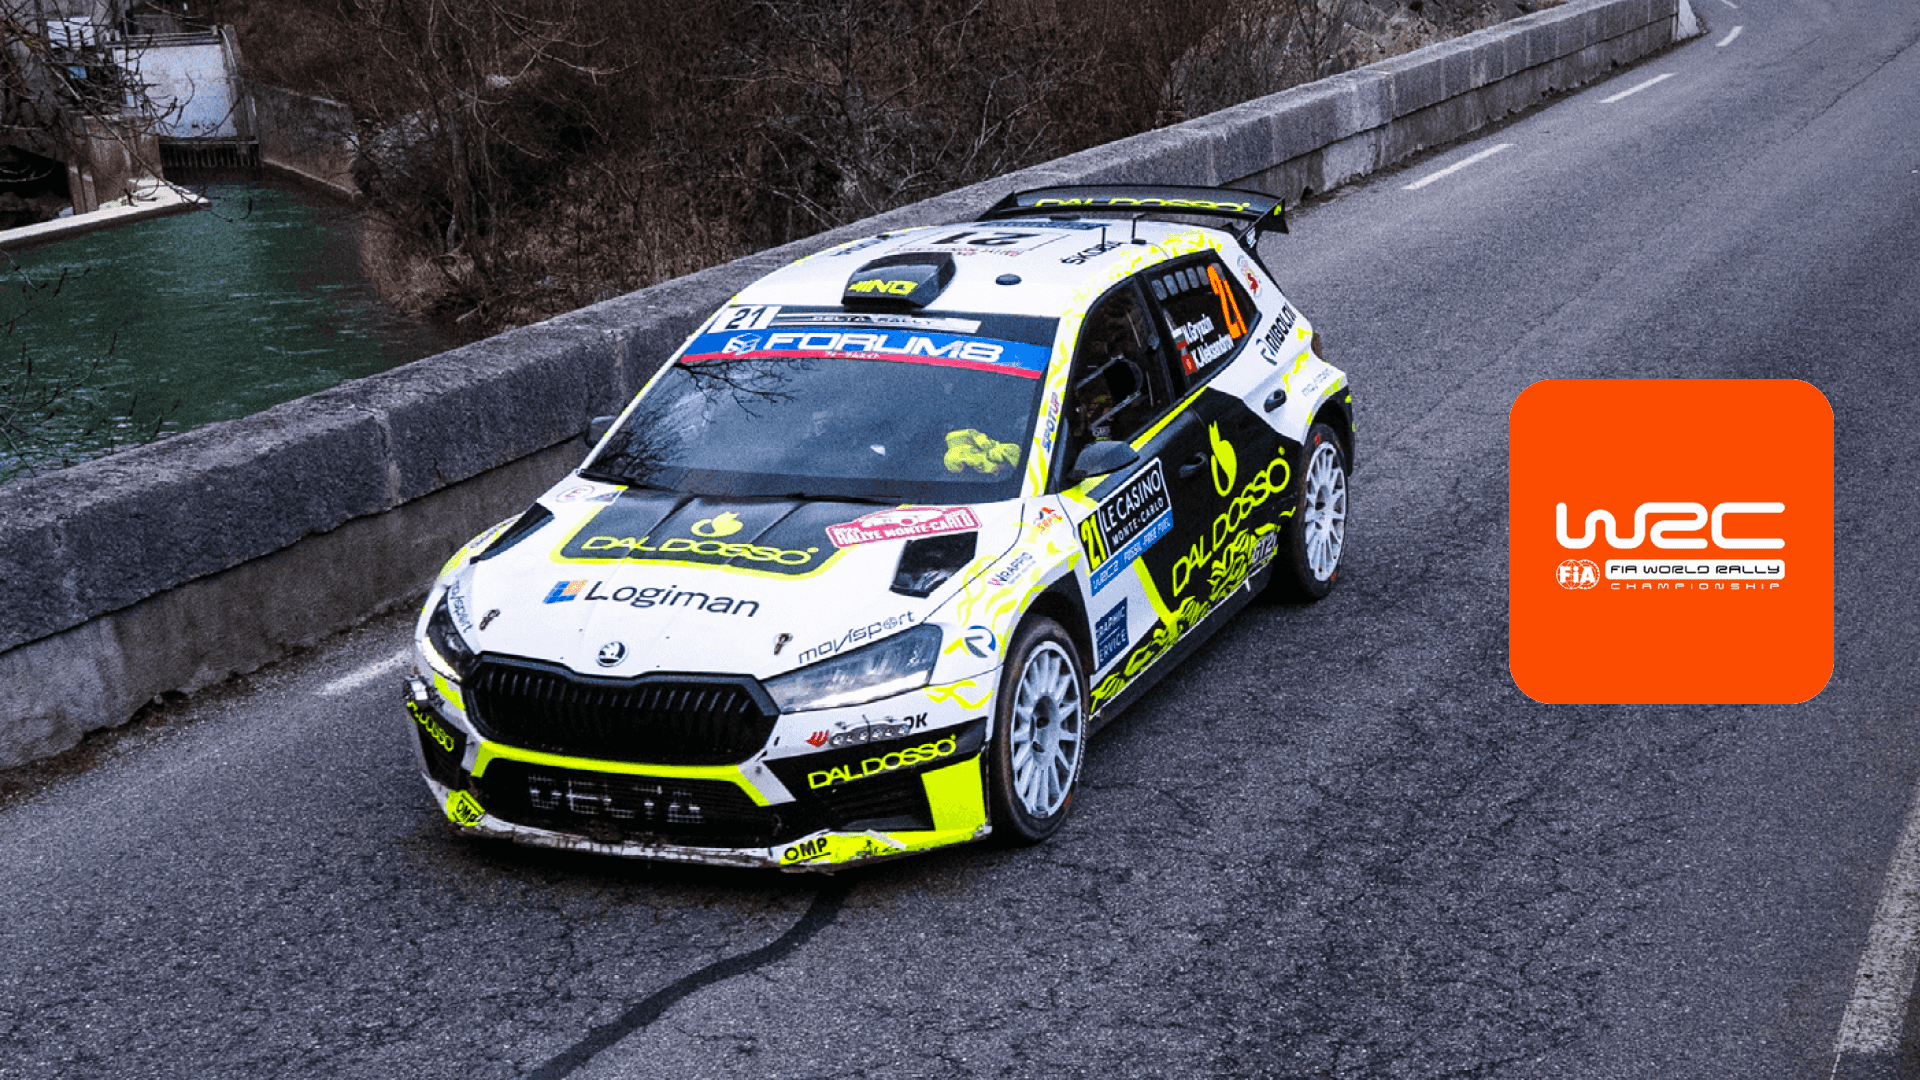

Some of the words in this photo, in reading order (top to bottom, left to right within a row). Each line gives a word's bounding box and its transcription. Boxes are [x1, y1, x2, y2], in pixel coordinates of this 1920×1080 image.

[725, 307, 764, 330] 21
[1206, 265, 1248, 339] 21
[762, 332, 1004, 363] FORUM8
[1101, 504, 1118, 532] LE
[1116, 469, 1161, 519] CASINO
[1111, 497, 1164, 546] MONTE-CARLO
[581, 536, 812, 565] DALDOSSO
[1080, 513, 1108, 570] 21
[1172, 457, 1291, 597] DALDOSSO
[583, 580, 760, 618] Logiman
[807, 738, 956, 789] DALDOSSO
[784, 837, 828, 861] OMP
